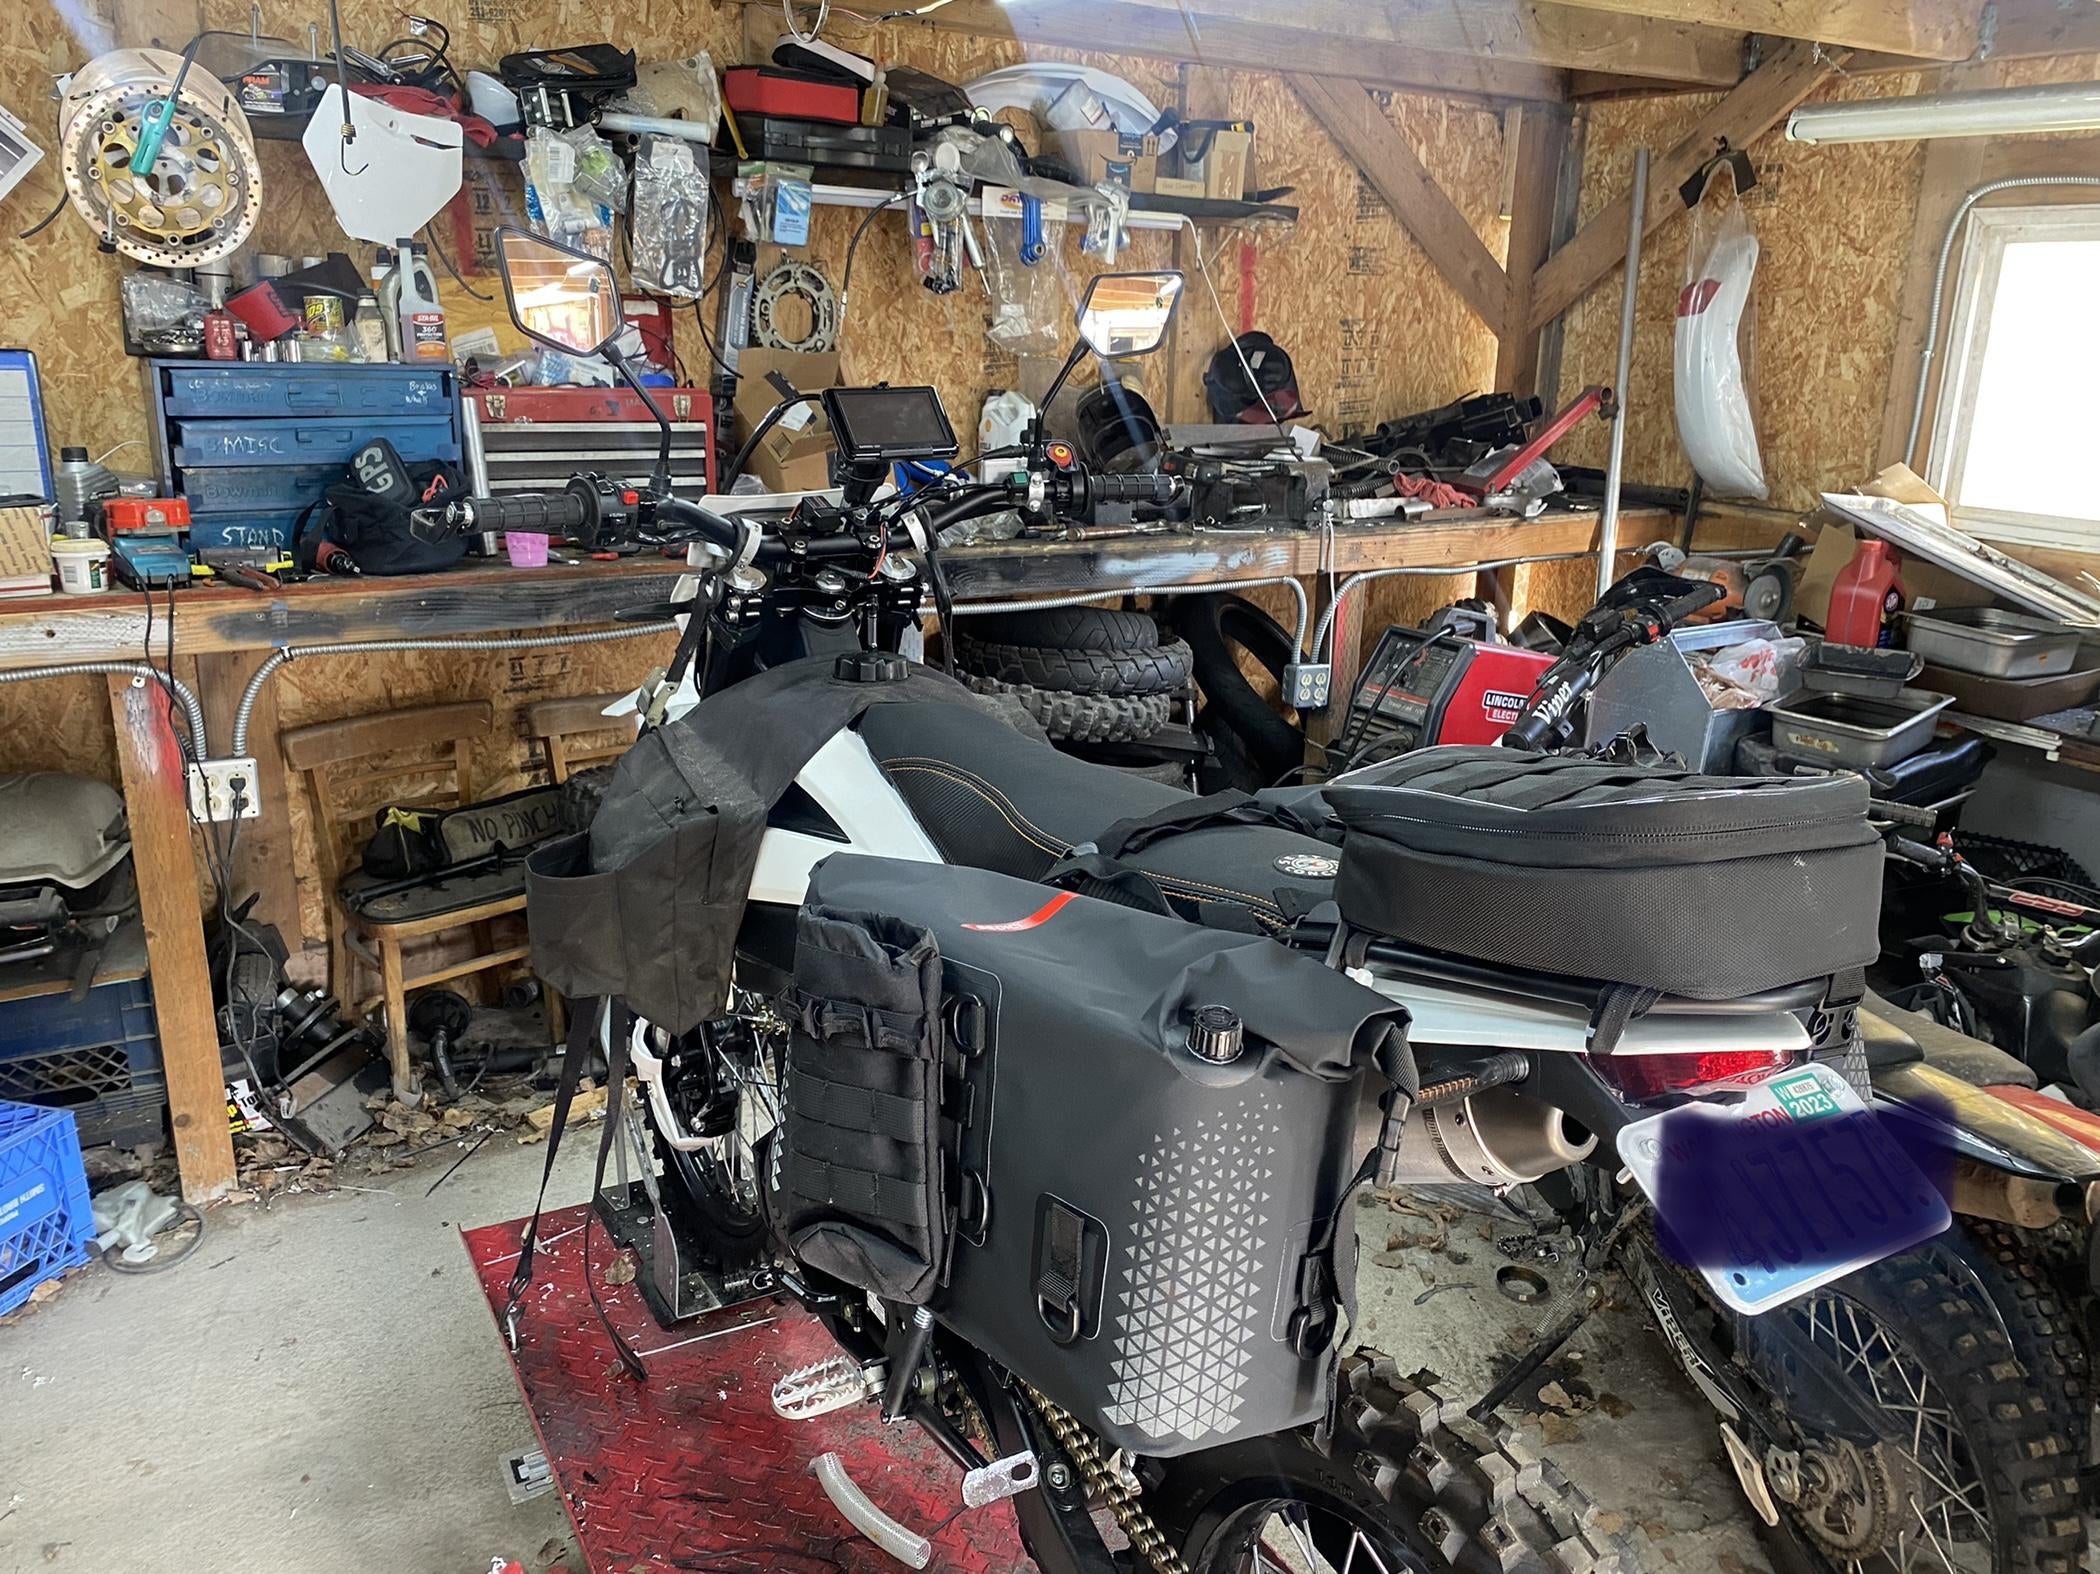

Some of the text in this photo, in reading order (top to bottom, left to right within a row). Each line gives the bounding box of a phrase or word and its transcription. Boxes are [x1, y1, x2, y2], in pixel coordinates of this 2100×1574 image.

[355, 447, 394, 494] GPS
[222, 526, 284, 546] STAND
[1492, 709, 1519, 721] ELECT
[1532, 681, 1574, 726] Viper
[468, 818, 499, 844] NO
[1789, 1093, 1834, 1118] 2023
[1652, 1287, 1701, 1368] VIPER
